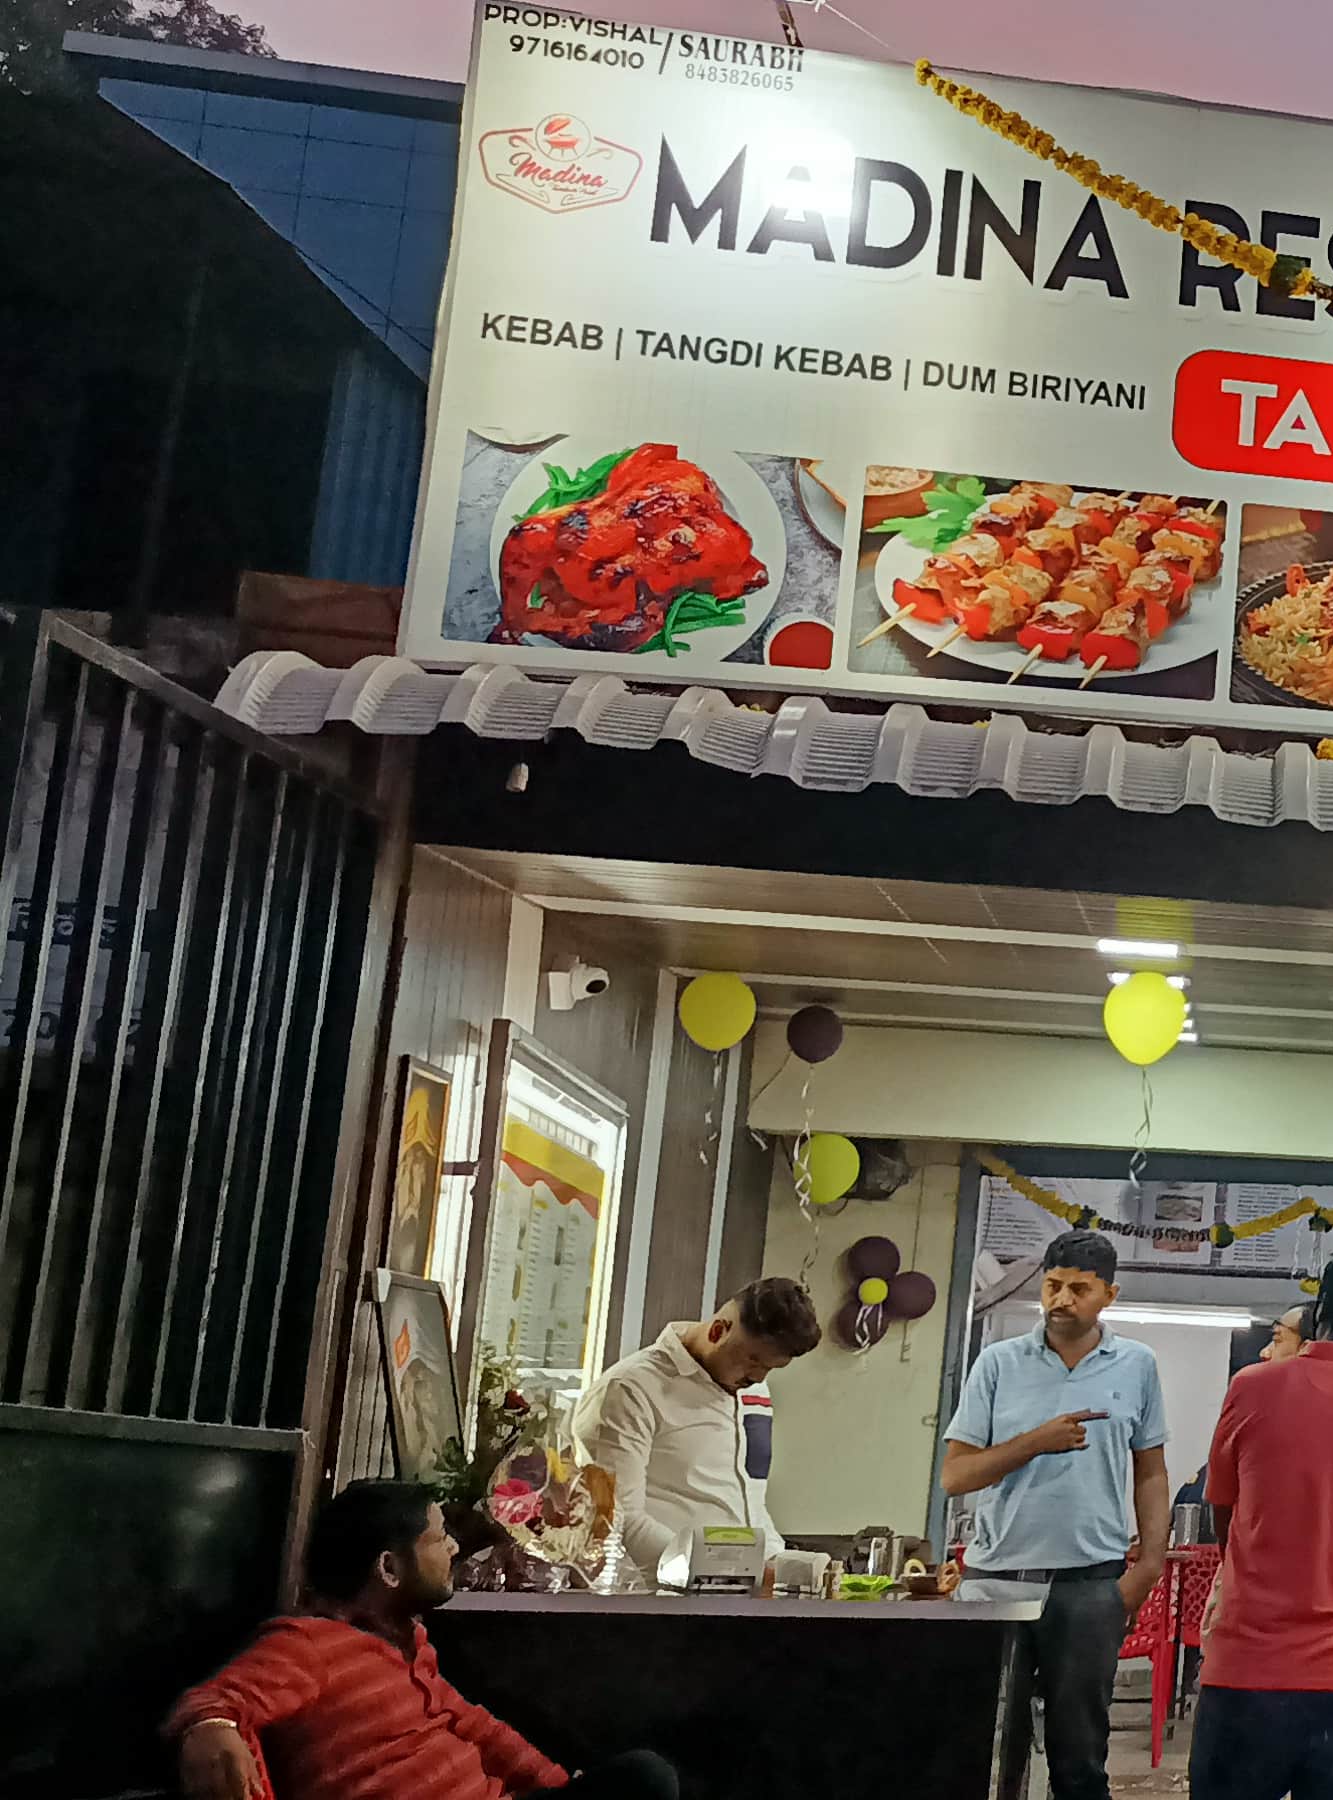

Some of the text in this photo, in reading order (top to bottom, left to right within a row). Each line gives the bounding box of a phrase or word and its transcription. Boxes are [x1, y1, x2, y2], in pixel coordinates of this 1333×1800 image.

[509, 35, 645, 69] 9716164010
[678, 34, 804, 73] SAURABH
[685, 63, 794, 92] 8483826065
[509, 152, 608, 188] Madina
[650, 133, 1130, 301] MADINA
[481, 312, 604, 351] KEBAB
[636, 329, 763, 368] TANGDI
[774, 344, 892, 382] KEBAB
[922, 360, 997, 395] DUM
[1007, 370, 1146, 411] BIRIYANI
